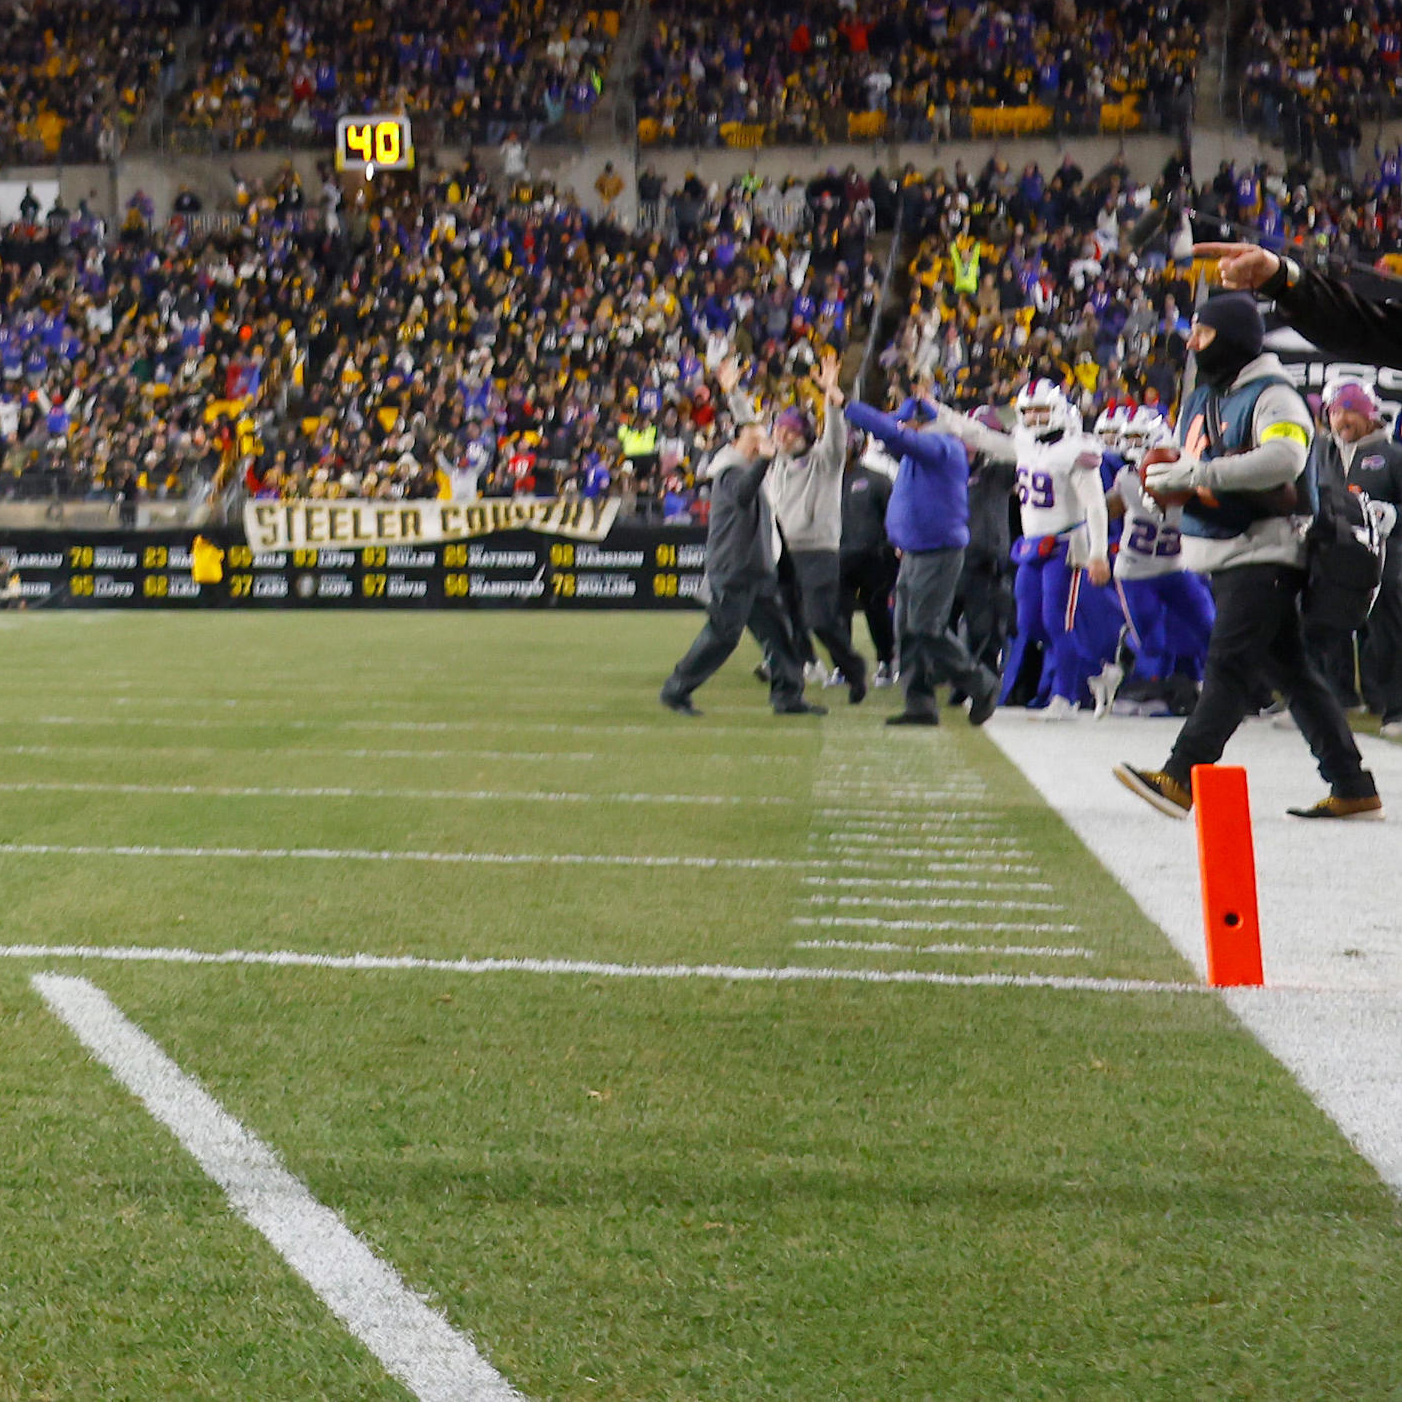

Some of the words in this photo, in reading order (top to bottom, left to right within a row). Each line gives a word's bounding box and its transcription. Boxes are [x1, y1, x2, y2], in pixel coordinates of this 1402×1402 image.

[347, 121, 400, 165] 40
[1017, 465, 1055, 508] 69
[255, 500, 422, 547] STEELER
